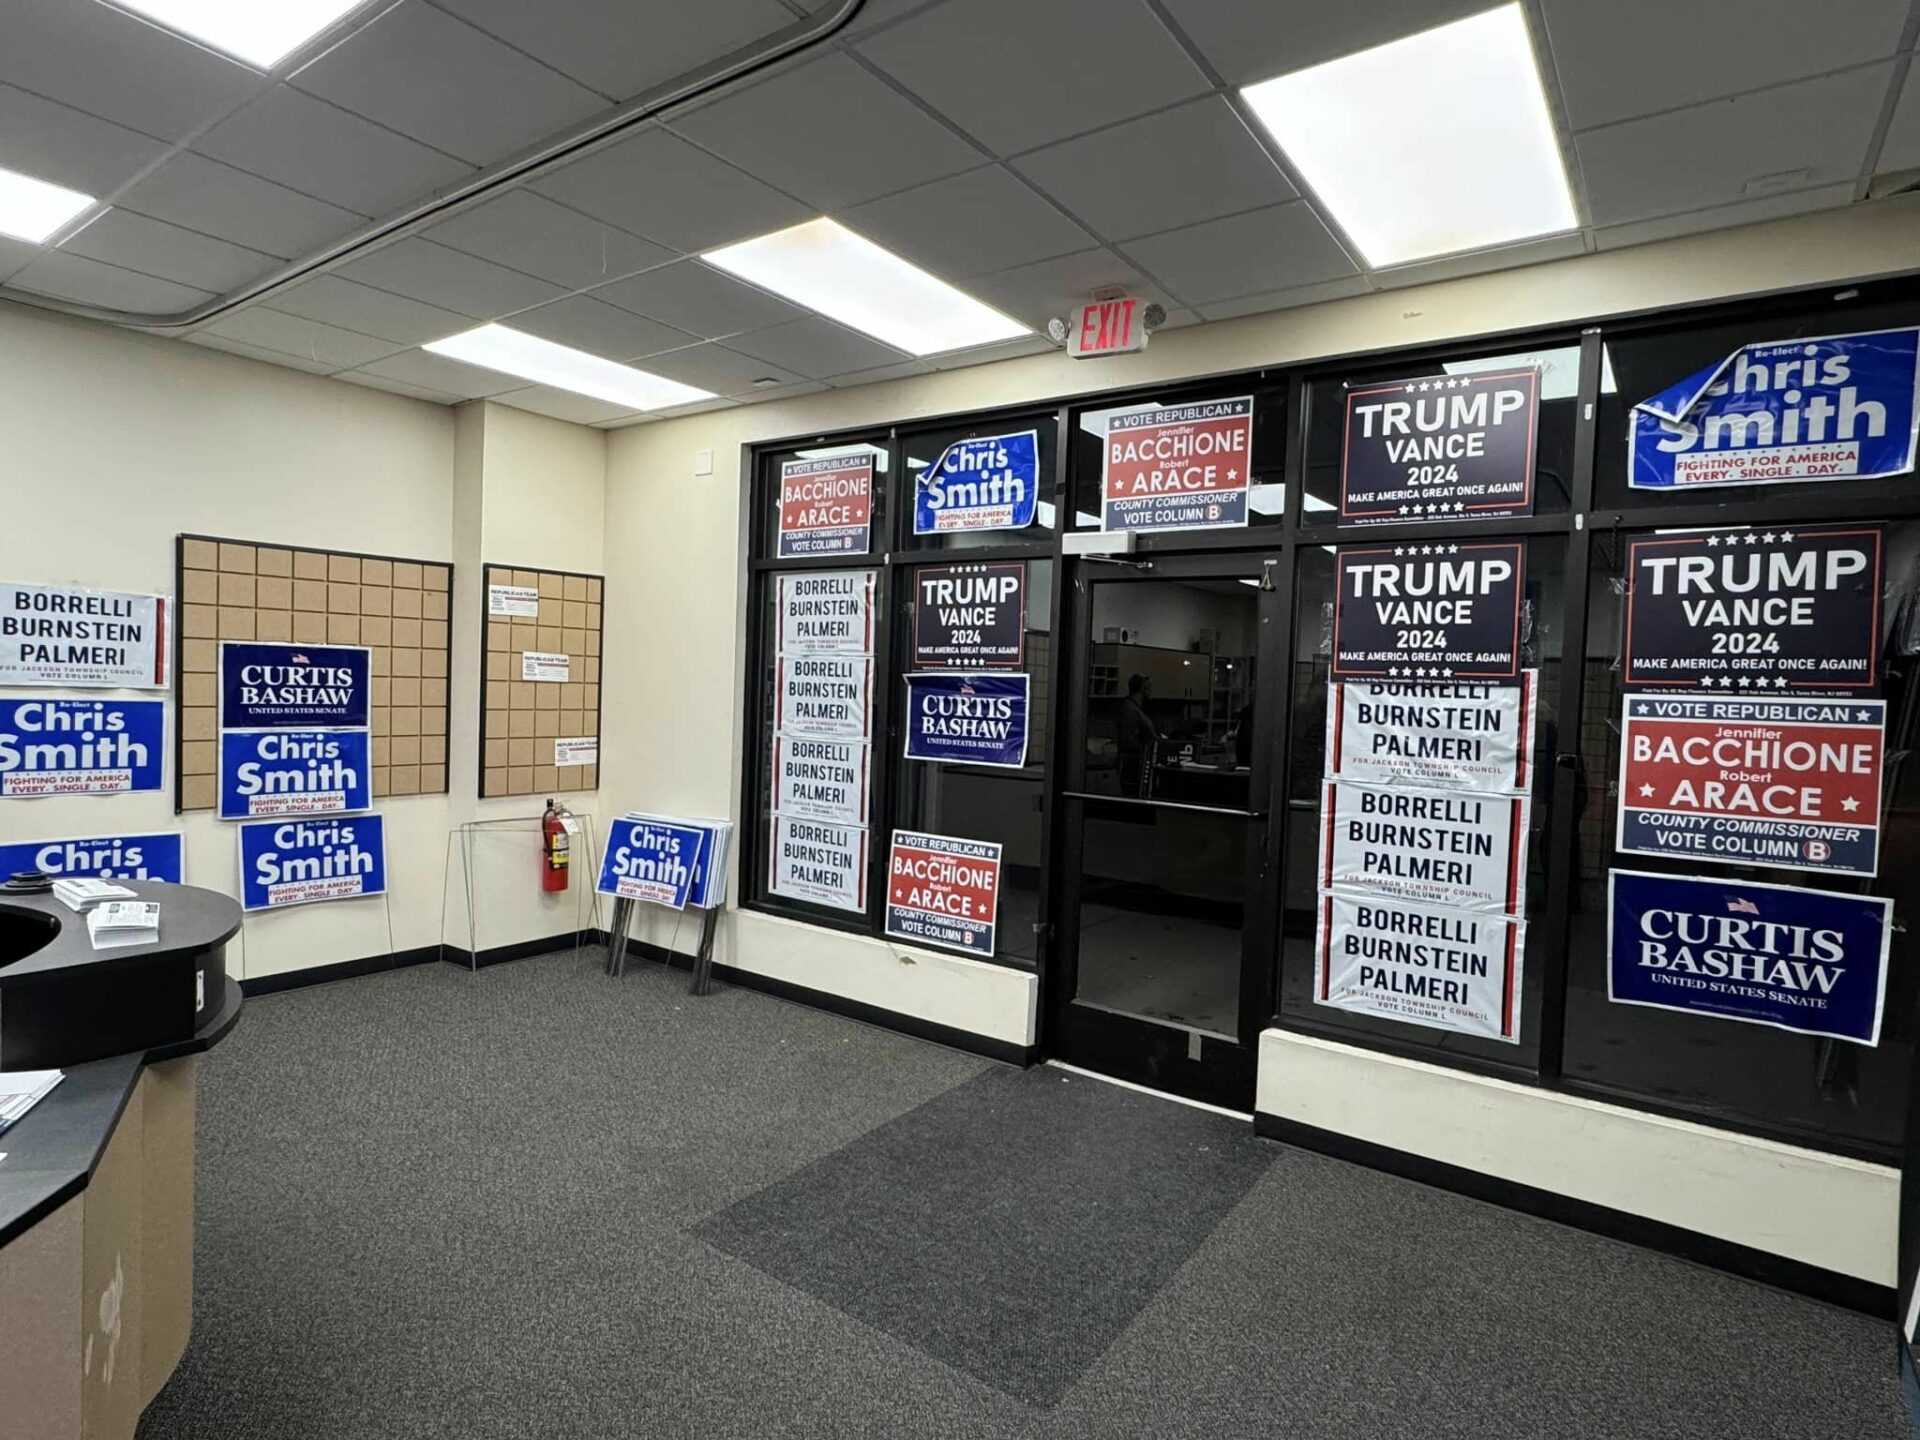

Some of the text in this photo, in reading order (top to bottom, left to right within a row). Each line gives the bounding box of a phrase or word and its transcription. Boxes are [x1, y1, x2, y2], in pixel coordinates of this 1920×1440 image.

[1080, 300, 1136, 352] EXIT
[1755, 346, 1799, 358] Re-Elect
[1123, 403, 1232, 427] VOTE REPUBLICAN
[1355, 389, 1525, 438] TRUMP
[1656, 386, 1887, 453] Smith
[942, 441, 1008, 473] Chris
[1111, 429, 1245, 464] BACCHIONE
[1385, 432, 1486, 464] VANCE
[793, 457, 860, 474] VOTE REPUBLICAN
[1677, 450, 1857, 472] FIGHTING FOR AMERICA
[1131, 465, 1217, 494] ARACE
[1407, 464, 1459, 486] 2024
[784, 477, 868, 503] BACCHIONE
[926, 469, 1025, 509] Smith
[1114, 492, 1238, 511] COUNTY COMMISSIONER
[1348, 482, 1524, 503] MAKE AMERICA GREAT ONCE AGAIN!
[796, 506, 851, 527] ARACE
[1123, 511, 1153, 525] VOTE
[1155, 507, 1204, 523] COLUMN
[1208, 505, 1221, 520] B
[786, 527, 863, 540] COUNTY COMMISSIONER
[792, 536, 853, 551] VOTE COLUMN B
[1346, 560, 1512, 597] TRUMP
[1641, 549, 1867, 595] TRUMP
[796, 579, 853, 596] BORRELLI
[921, 576, 1019, 606] TRUMP
[15, 591, 132, 618] BORRELLI
[789, 600, 858, 616] BURNSTEIN
[938, 607, 996, 626] VANCE
[1375, 600, 1473, 625] VANCE
[1682, 597, 1815, 627] VANCE
[3, 616, 142, 642] BURNSTEIN
[797, 621, 849, 637] PALMERI
[951, 629, 982, 644] 2024
[1396, 630, 1447, 649] 2024
[20, 643, 126, 665] PALMERI
[918, 646, 933, 654] MAKE
[934, 646, 960, 654] AMERICA
[1711, 632, 1780, 654] 2024
[795, 661, 852, 678] BORRELLI
[1340, 651, 1511, 663] MAKE AMERICA GREAT ONCE AGAIN!
[1633, 657, 1868, 671] MAKE AMERICA GREAT ONCE AGAIN!
[241, 665, 353, 687] CURTIS
[240, 687, 354, 706] BASHAW
[789, 681, 857, 700] BURNSTEIN
[14, 702, 126, 732] Chris
[796, 702, 848, 720] PALMERI
[922, 694, 1012, 719] CURTIS
[1357, 703, 1502, 732] BURNSTEIN
[1654, 702, 1850, 722] VOTE REPUBLICAN
[921, 716, 1012, 740] BASHAW
[0, 731, 148, 771] Smith
[257, 734, 340, 760] Chris
[792, 742, 849, 762] BORRELLI
[927, 737, 1005, 750] UNITED STATES SENATE
[1372, 733, 1481, 762] PALMERI
[1633, 735, 1873, 774] BACCHIONE
[4, 773, 130, 785] FIGHTING FOR AMERICA
[236, 759, 357, 795] Smith
[786, 762, 854, 784] BURNSTEIN
[1372, 759, 1502, 775] JACKSON TOWNSHIP COUNCIL
[1391, 767, 1450, 778] VOTE COLUMN
[1720, 769, 1773, 783] Robert
[793, 783, 845, 804] PALMERI
[1669, 780, 1822, 817] ARACE
[1361, 792, 1482, 824] BORRELLI
[274, 820, 355, 849] Chris
[630, 825, 681, 854] Chris
[790, 823, 847, 847] BORRELLI
[1349, 820, 1492, 857] BURNSTEIN
[1638, 812, 1860, 842] COUNTY COMMISSIONER
[35, 839, 143, 873] Chris
[784, 843, 852, 869] BURNSTEIN
[904, 836, 986, 856] VOTE REPUBLICAN
[1655, 830, 1707, 849] VOTE
[1711, 836, 1798, 858] COLUMN
[1807, 843, 1826, 860] B
[256, 844, 373, 886] Smith
[612, 846, 687, 887] Smith
[791, 864, 843, 888] PALMERI
[893, 856, 994, 890] BACCHIONE
[1363, 852, 1472, 886] PALMERI
[908, 887, 972, 916] ARACE
[894, 908, 987, 933] COUNTY COMMISSIONER
[901, 920, 924, 934] VOTE
[925, 925, 961, 942] COLUMN
[963, 931, 973, 944] B
[1357, 906, 1477, 944] BORRELLI
[1640, 909, 1844, 963] CURTIS
[1344, 934, 1488, 978] BURNSTEIN
[1637, 940, 1846, 994] BASHAW
[1360, 966, 1468, 1005] PALMERI
[1651, 973, 1707, 989] UNITED
[1709, 981, 1766, 999] STATES
[1768, 991, 1828, 1010] SENATE
[1359, 990, 1490, 1021] JACKSON TOWNSHIP COUNCIL
[1377, 1001, 1438, 1018] VOTE COLUMN
